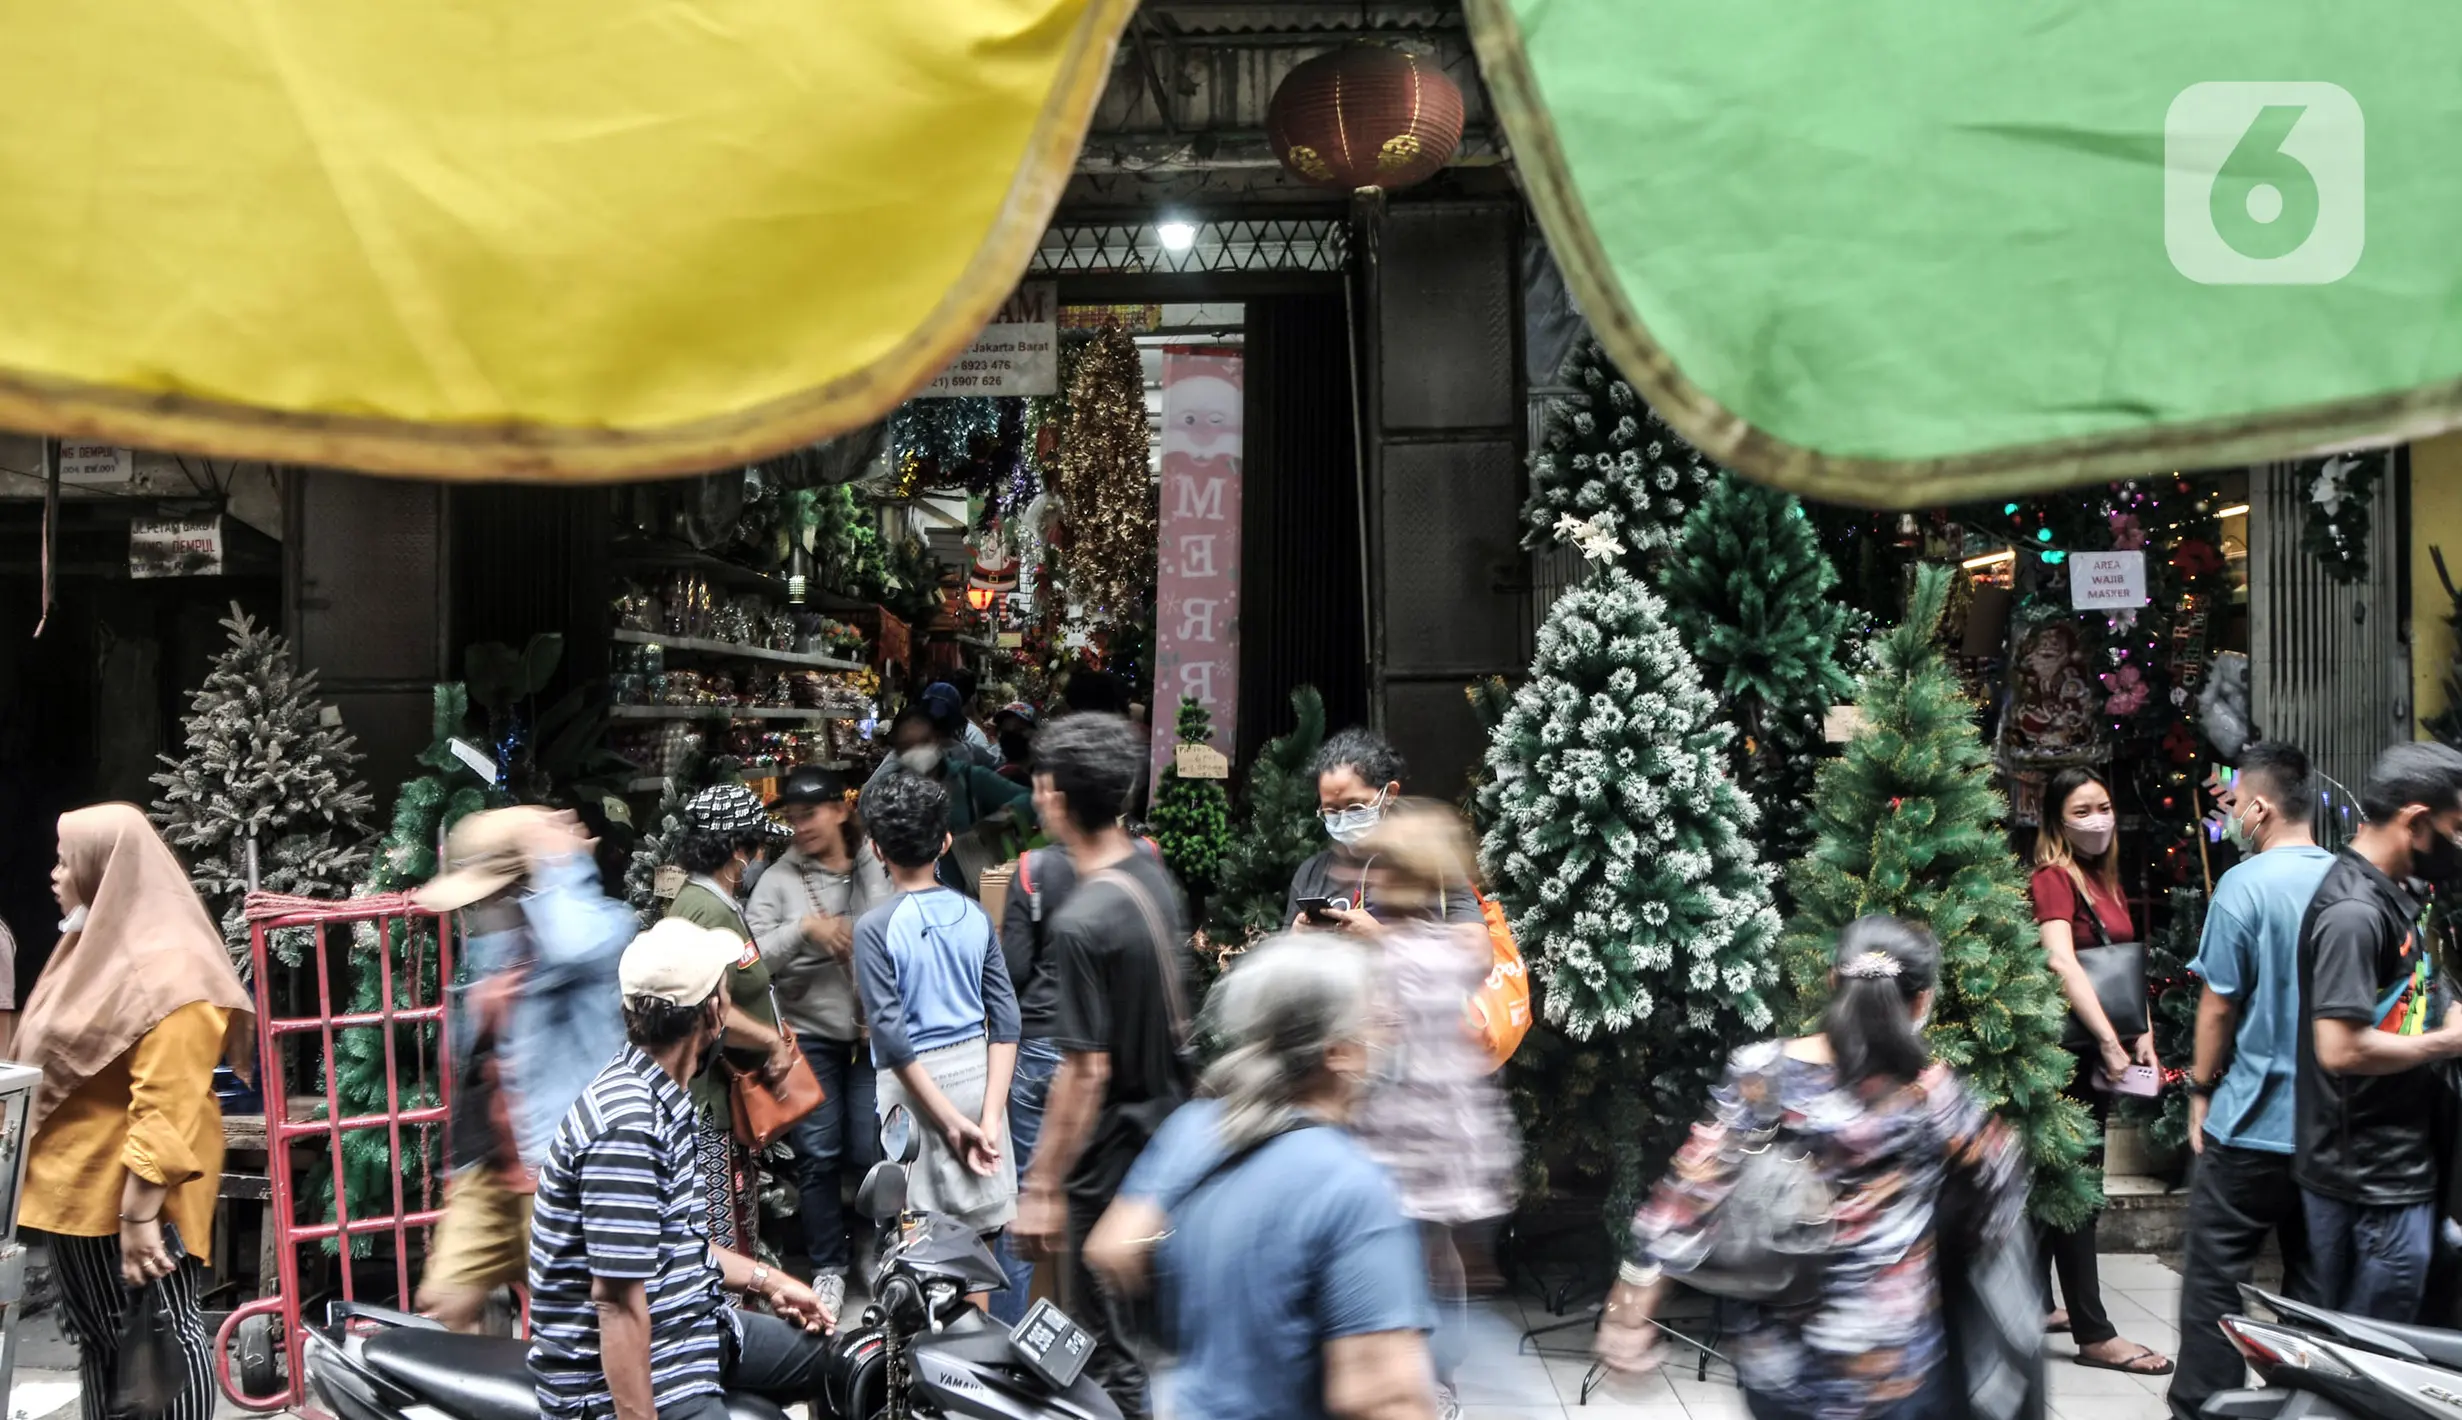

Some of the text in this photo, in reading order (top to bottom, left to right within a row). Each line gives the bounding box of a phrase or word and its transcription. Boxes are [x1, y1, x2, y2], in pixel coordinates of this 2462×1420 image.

[992, 290, 1045, 323] AM
[972, 341, 1049, 353] Jakarta Barat
[961, 360, 988, 371] 6923
[991, 359, 1012, 370] 476
[931, 376, 949, 389] 21)
[981, 375, 1003, 387] 626
[61, 447, 74, 459] NG
[173, 539, 215, 553] DEMPUL
[2094, 560, 2121, 570] AREA
[2091, 575, 2125, 585] WAJIB
[2088, 588, 2130, 599] MASKER
